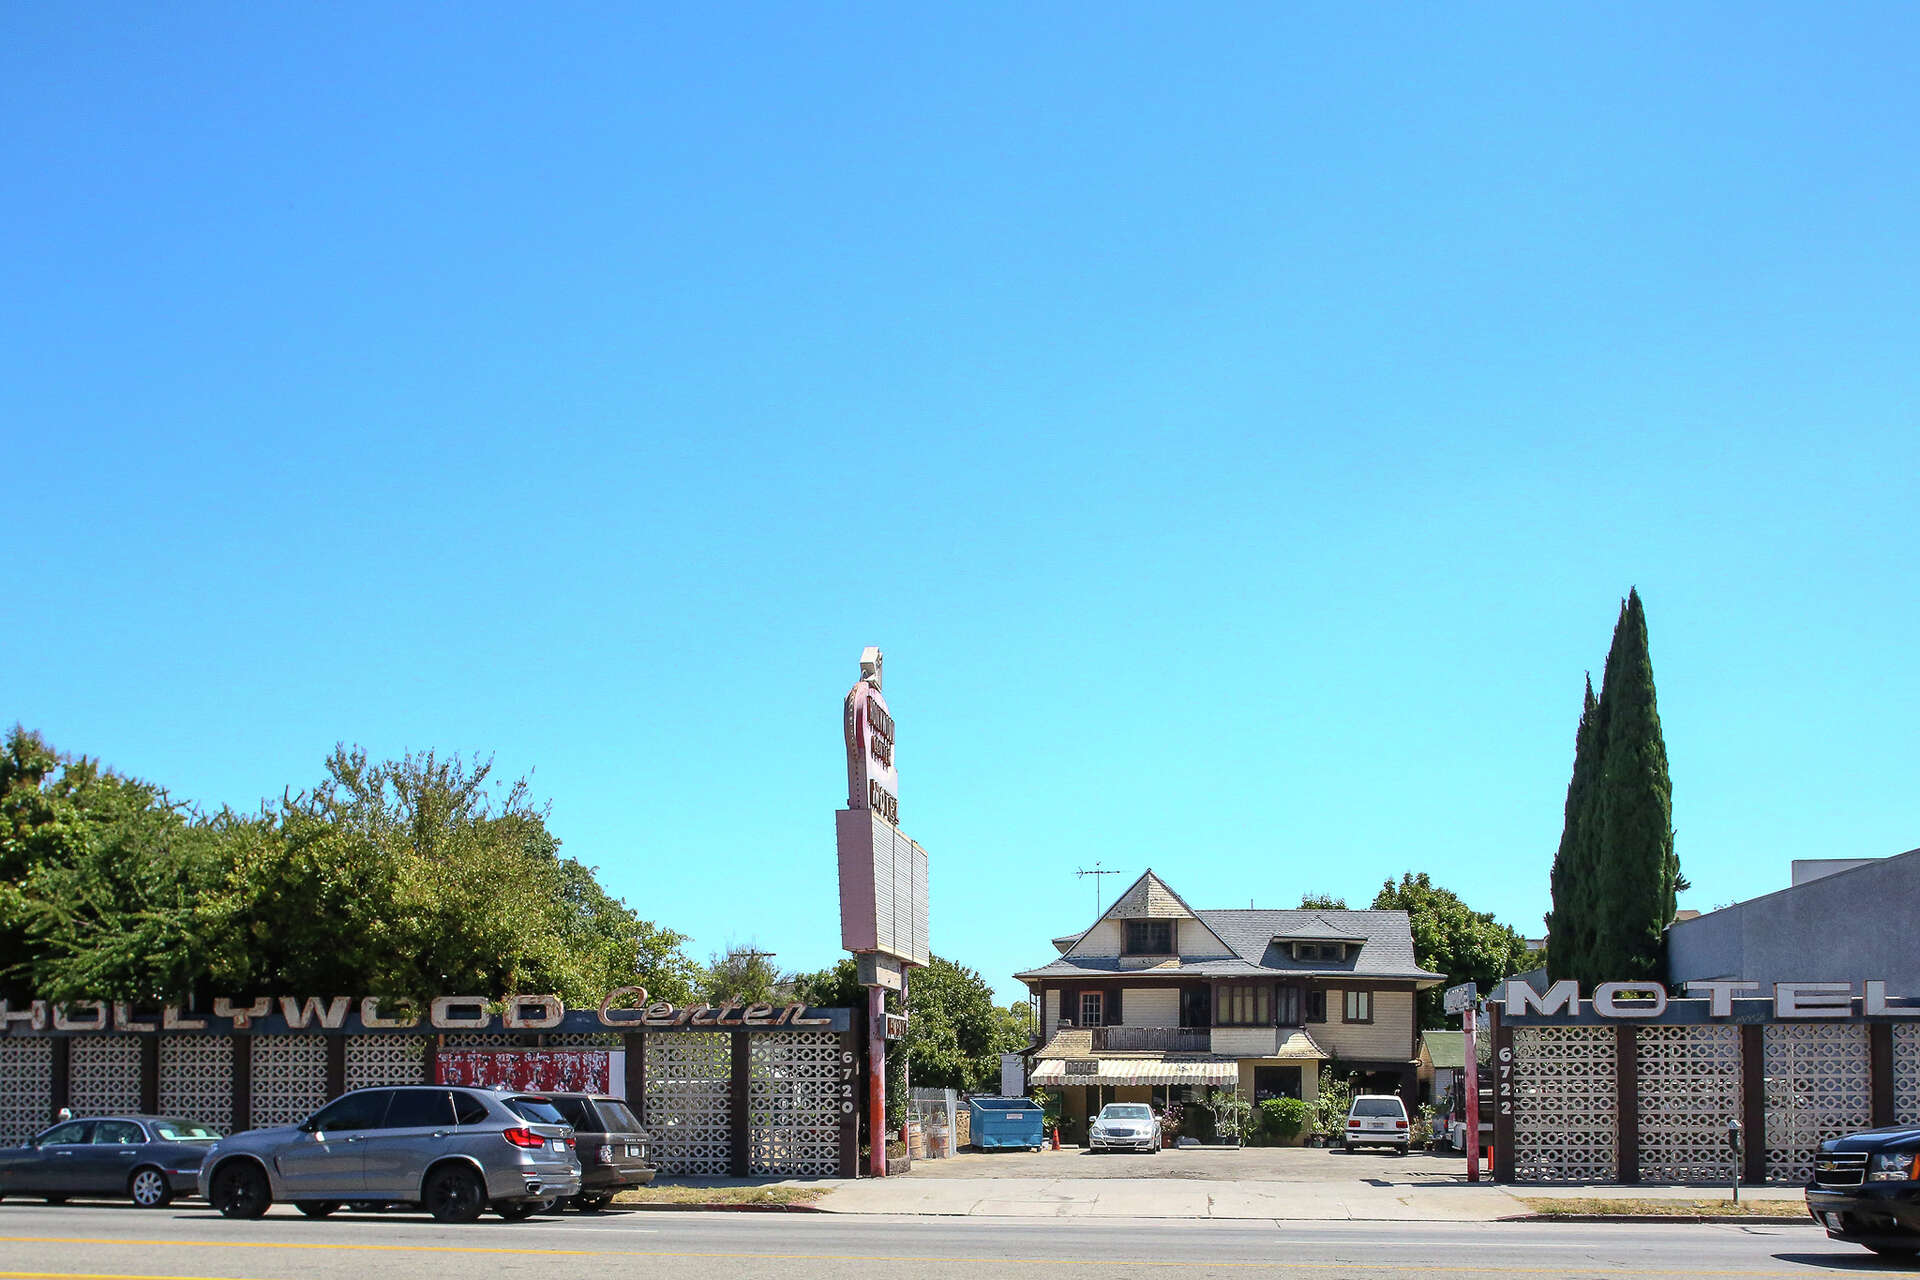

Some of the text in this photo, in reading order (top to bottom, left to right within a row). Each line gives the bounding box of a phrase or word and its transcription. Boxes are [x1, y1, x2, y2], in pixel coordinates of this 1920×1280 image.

[0, 985, 832, 1031] HOLLYWOOD Center
[1505, 979, 1920, 1018] MOTEL
[841, 1050, 854, 1114] 6720
[1498, 1046, 1512, 1115] 6722
